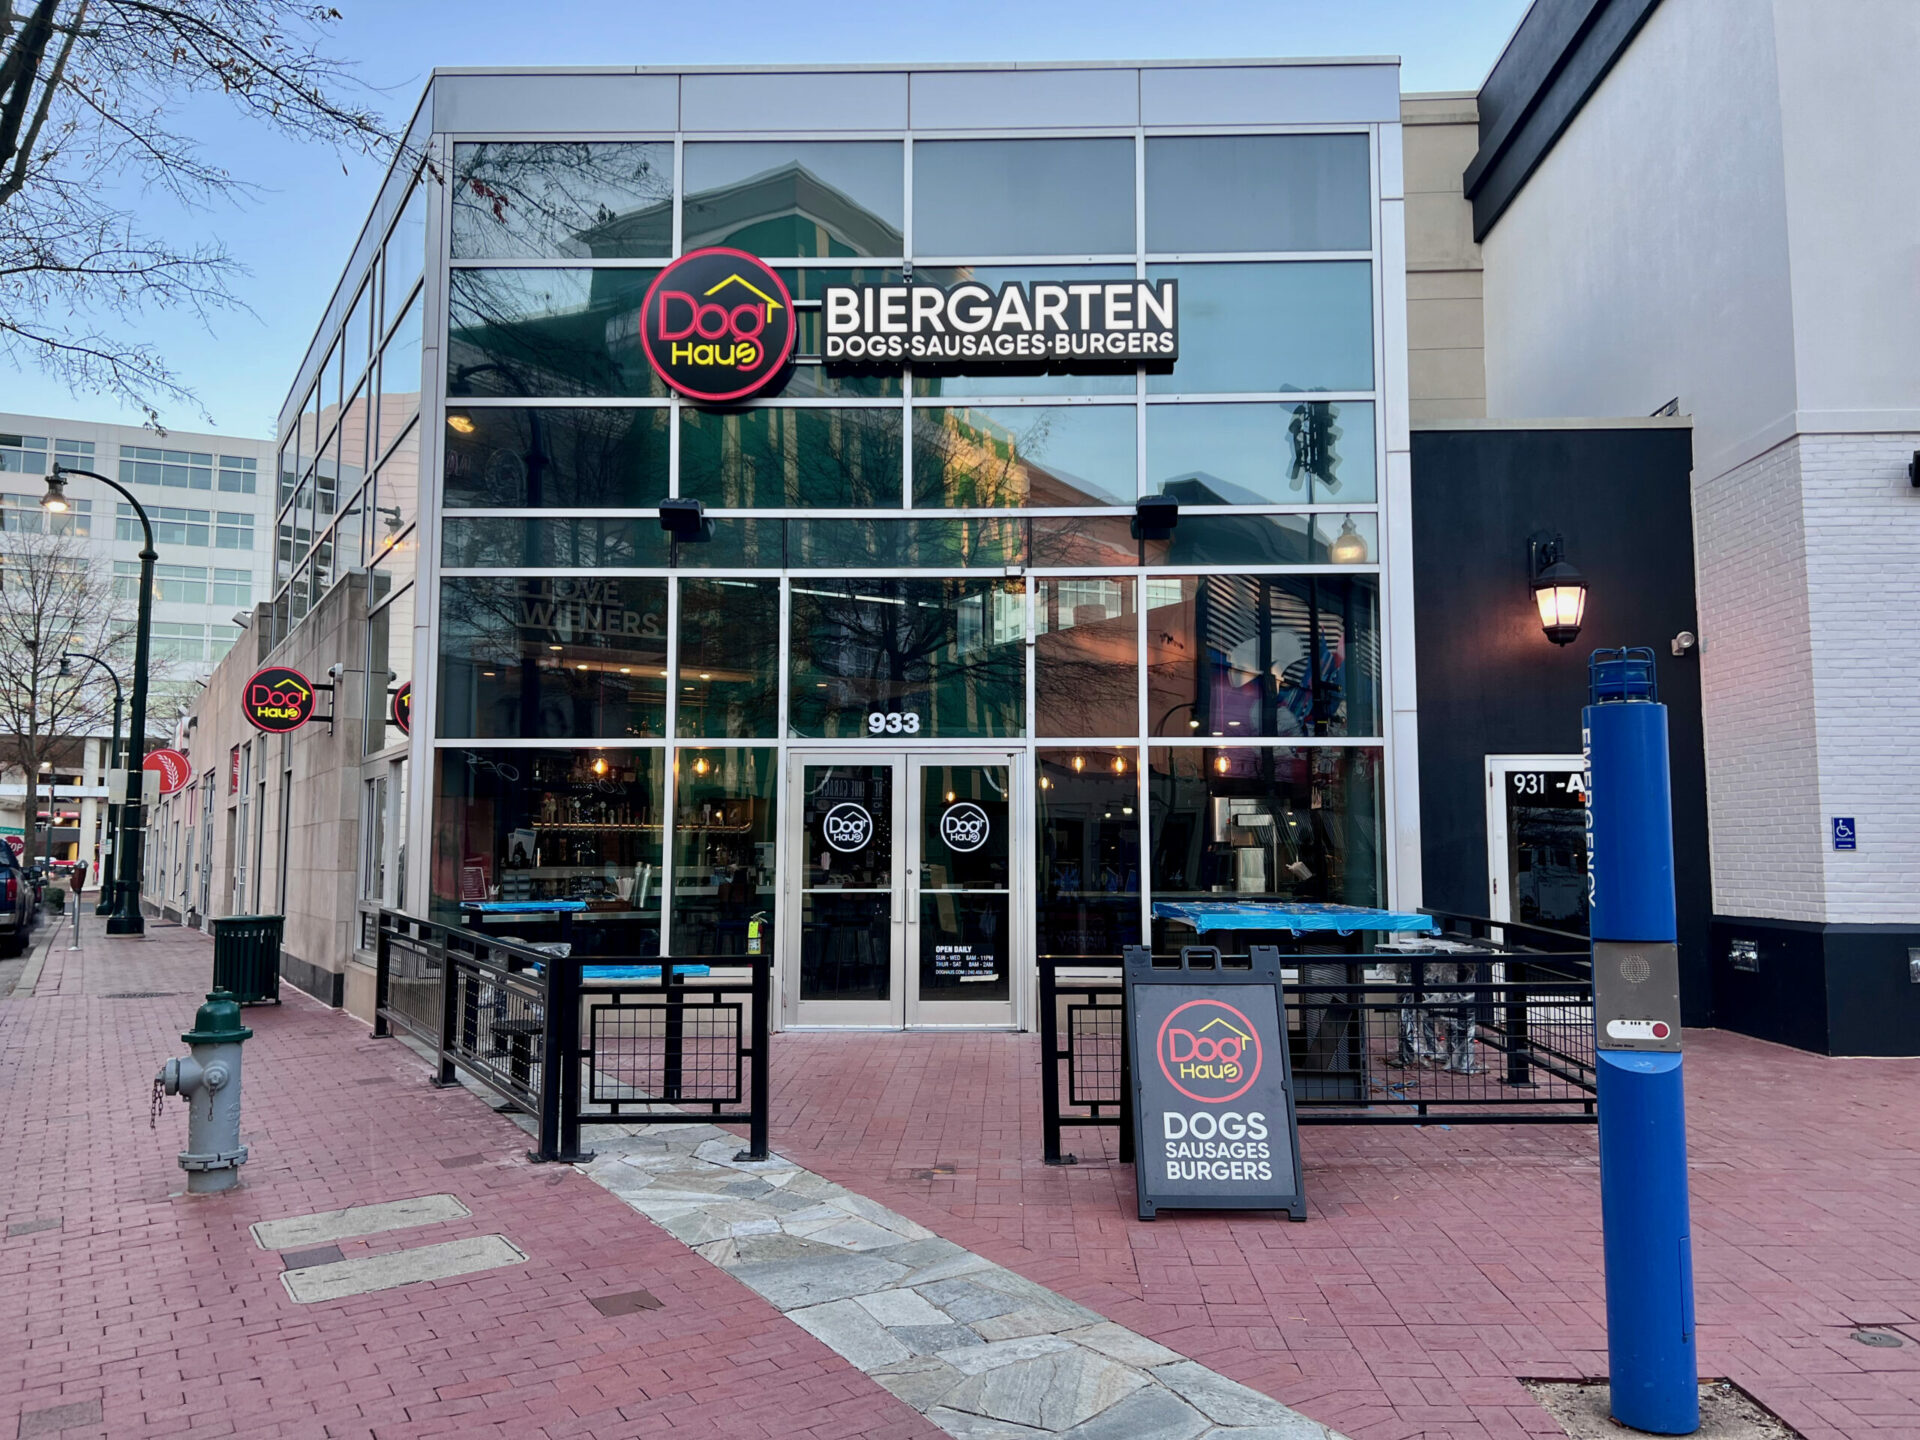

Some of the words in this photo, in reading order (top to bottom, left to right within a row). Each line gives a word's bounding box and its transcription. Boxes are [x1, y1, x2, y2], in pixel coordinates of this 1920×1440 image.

[826, 283, 1173, 334] BIERGARTEN
[658, 290, 766, 372] Dog
[671, 342, 756, 366] Haus
[521, 602, 660, 636] WIENERS
[252, 684, 302, 721] Dog
[257, 706, 299, 718] Haus
[868, 712, 920, 734] 933
[1513, 773, 1545, 794] 931
[829, 817, 864, 843] Dog
[946, 816, 980, 843] Dog
[1581, 728, 1597, 908] EMERGENCY
[833, 833, 861, 842] Haus
[950, 833, 978, 841] Haus
[935, 945, 953, 953] OPEN
[953, 945, 972, 953] DAILY
[1168, 1028, 1244, 1083] Dog
[1179, 1063, 1238, 1079] Haus
[1163, 1111, 1269, 1141] DOGS
[1165, 1142, 1271, 1159] SAUSAGES
[1166, 1161, 1273, 1181] BURGERS
